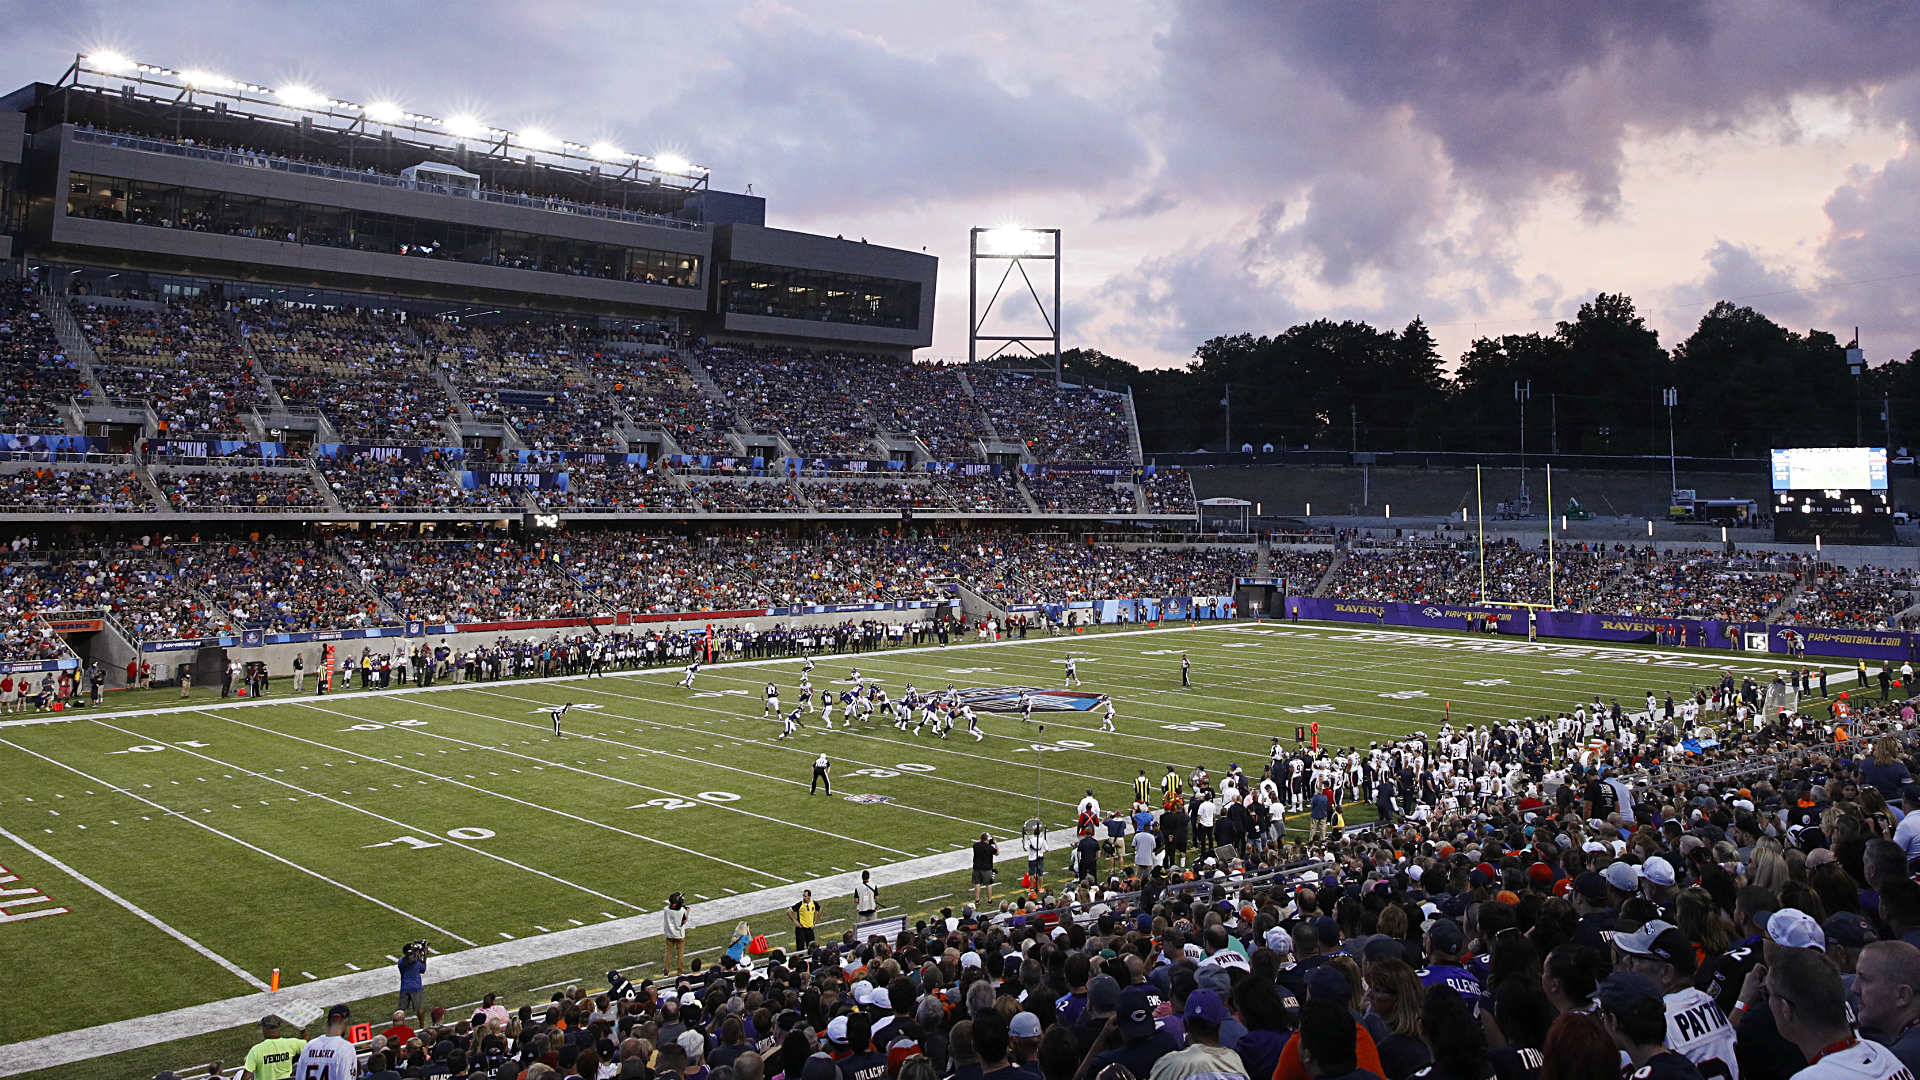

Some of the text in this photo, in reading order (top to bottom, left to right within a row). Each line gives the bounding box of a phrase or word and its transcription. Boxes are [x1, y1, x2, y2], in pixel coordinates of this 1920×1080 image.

[490, 473, 512, 487] CLASS
[514, 474, 522, 486] OF
[1601, 620, 1656, 633] RAVEN
[855, 763, 937, 778] 30
[646, 791, 741, 811] 20
[391, 827, 496, 850] 10
[757, 936, 768, 951] 10
[1215, 953, 1243, 966] PAYTON
[1446, 978, 1482, 996] R.LEWIS
[355, 1026, 367, 1041] G
[263, 1052, 290, 1065] VENDOR
[308, 1049, 335, 1059] URLACHER
